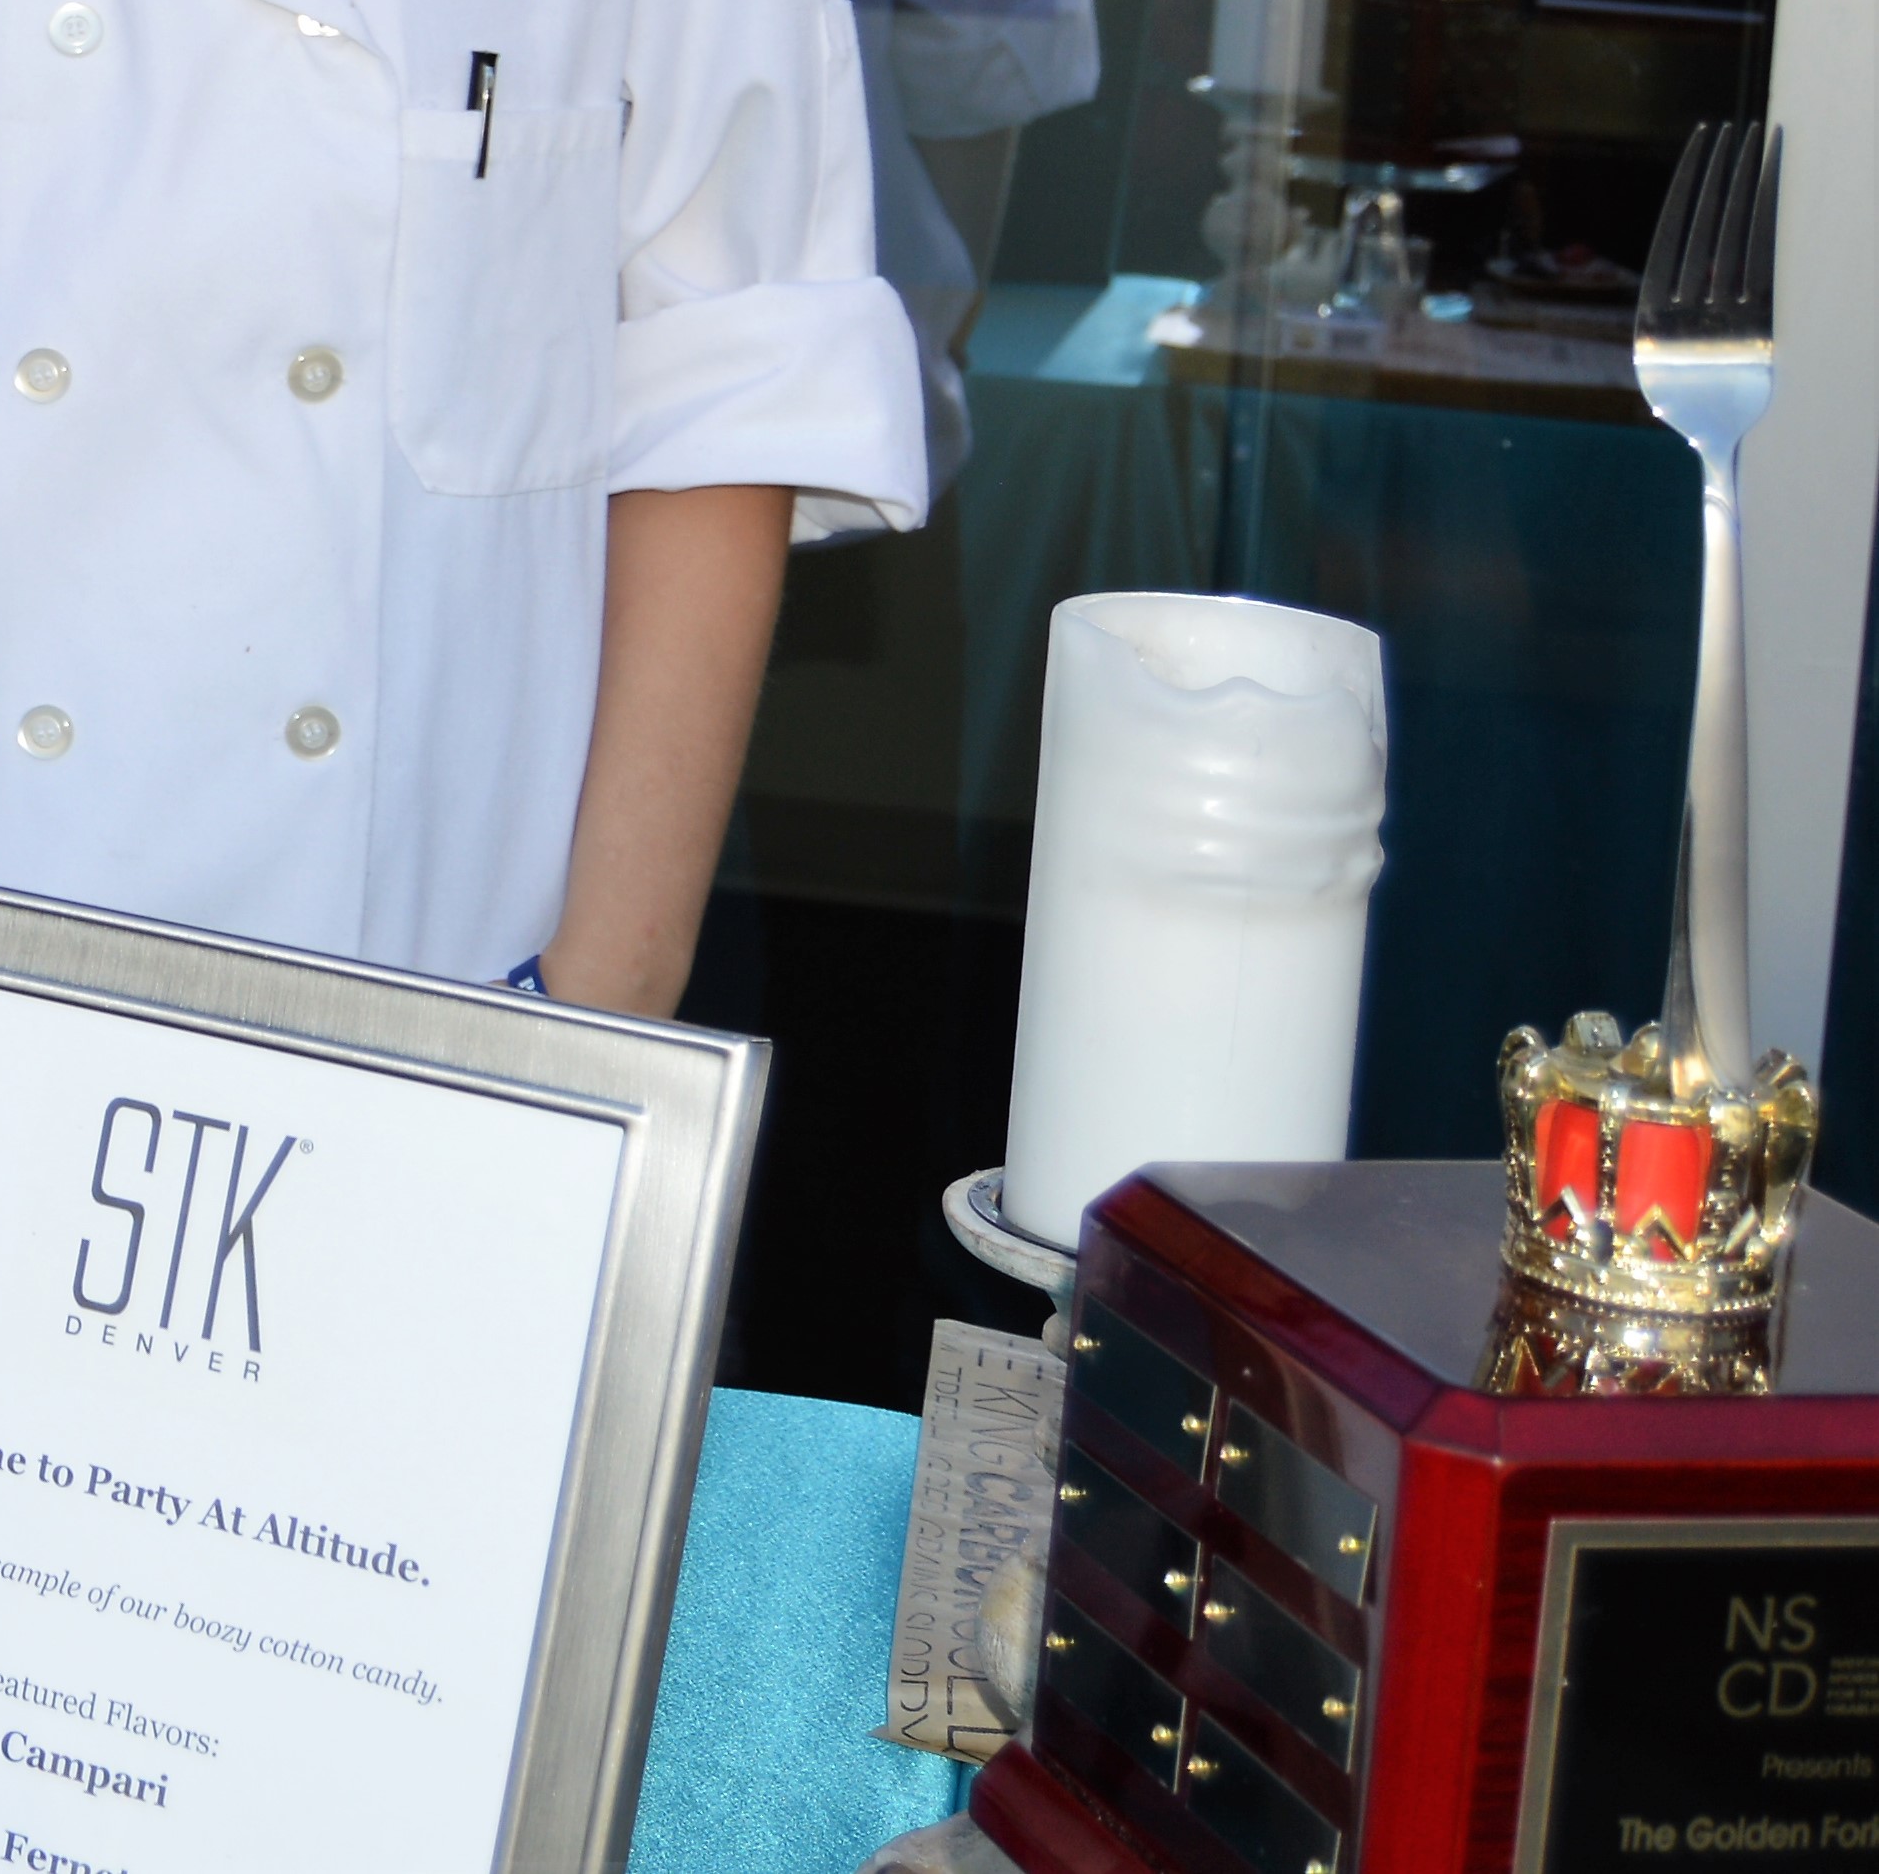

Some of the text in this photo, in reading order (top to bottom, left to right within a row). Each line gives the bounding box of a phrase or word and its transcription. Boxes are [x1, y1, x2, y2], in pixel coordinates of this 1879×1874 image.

[70, 1096, 297, 1353] STK
[63, 1315, 265, 1386] DENVER
[37, 1454, 75, 1487] to
[84, 1464, 192, 1526] Party
[198, 1498, 248, 1537] At
[252, 1513, 432, 1589] Altitude.
[87, 1583, 123, 1613] of
[119, 1595, 168, 1623] our
[173, 1603, 252, 1653] boozy
[258, 1631, 344, 1677] cotton
[351, 1658, 444, 1706] candy.
[1724, 1595, 1818, 1652] NS
[1717, 1660, 1817, 1719] CD
[105, 1699, 220, 1759] Flavors:
[1, 1730, 168, 1808] Campari
[0, 1829, 129, 1874] Fern
[1619, 1816, 1676, 1852] The
[1687, 1815, 1809, 1852] Golden
